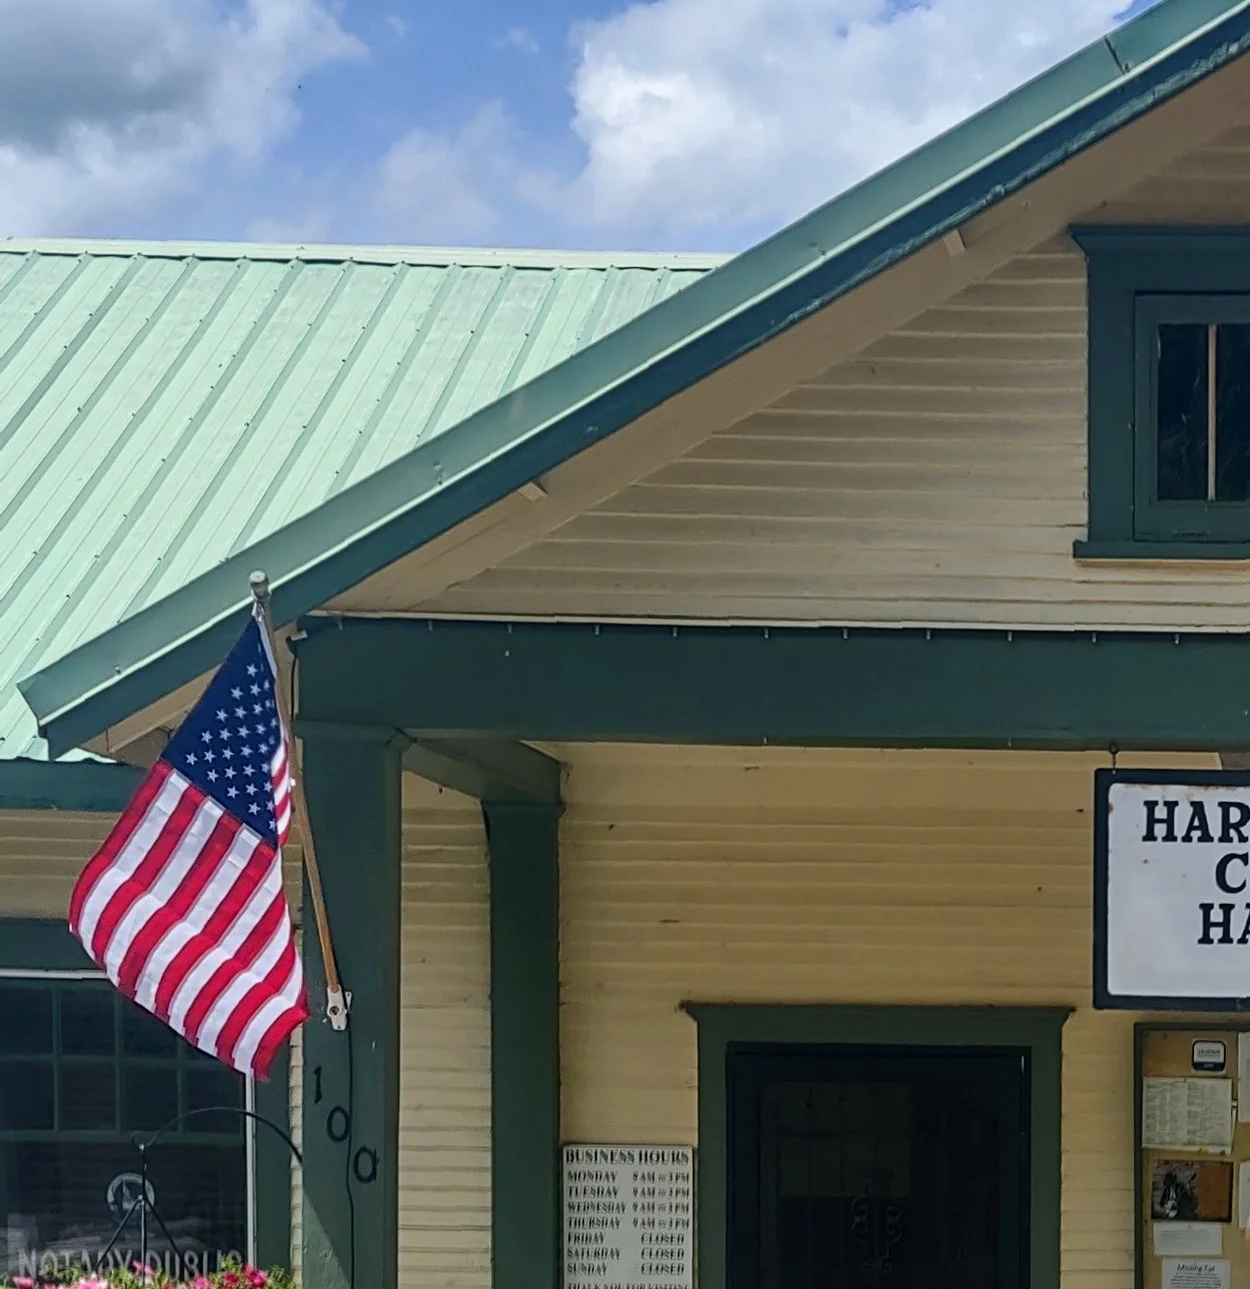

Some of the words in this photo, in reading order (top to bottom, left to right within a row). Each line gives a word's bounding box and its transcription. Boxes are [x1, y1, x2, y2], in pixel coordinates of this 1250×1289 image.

[566, 1149, 635, 1164] BUSINESS
[639, 1149, 689, 1165] HOURS
[567, 1171, 618, 1183] MONDAY
[567, 1186, 620, 1198] TUESDAY
[567, 1201, 627, 1214] WEDNESDAY
[567, 1216, 621, 1229] THURSDAY
[567, 1232, 606, 1245] FRIDAY
[641, 1233, 685, 1246] CLOSED
[567, 1247, 622, 1260] SATURDAY
[641, 1248, 685, 1260] CLOSED
[567, 1262, 608, 1276] SUNDAY
[641, 1263, 685, 1275] CLOSED
